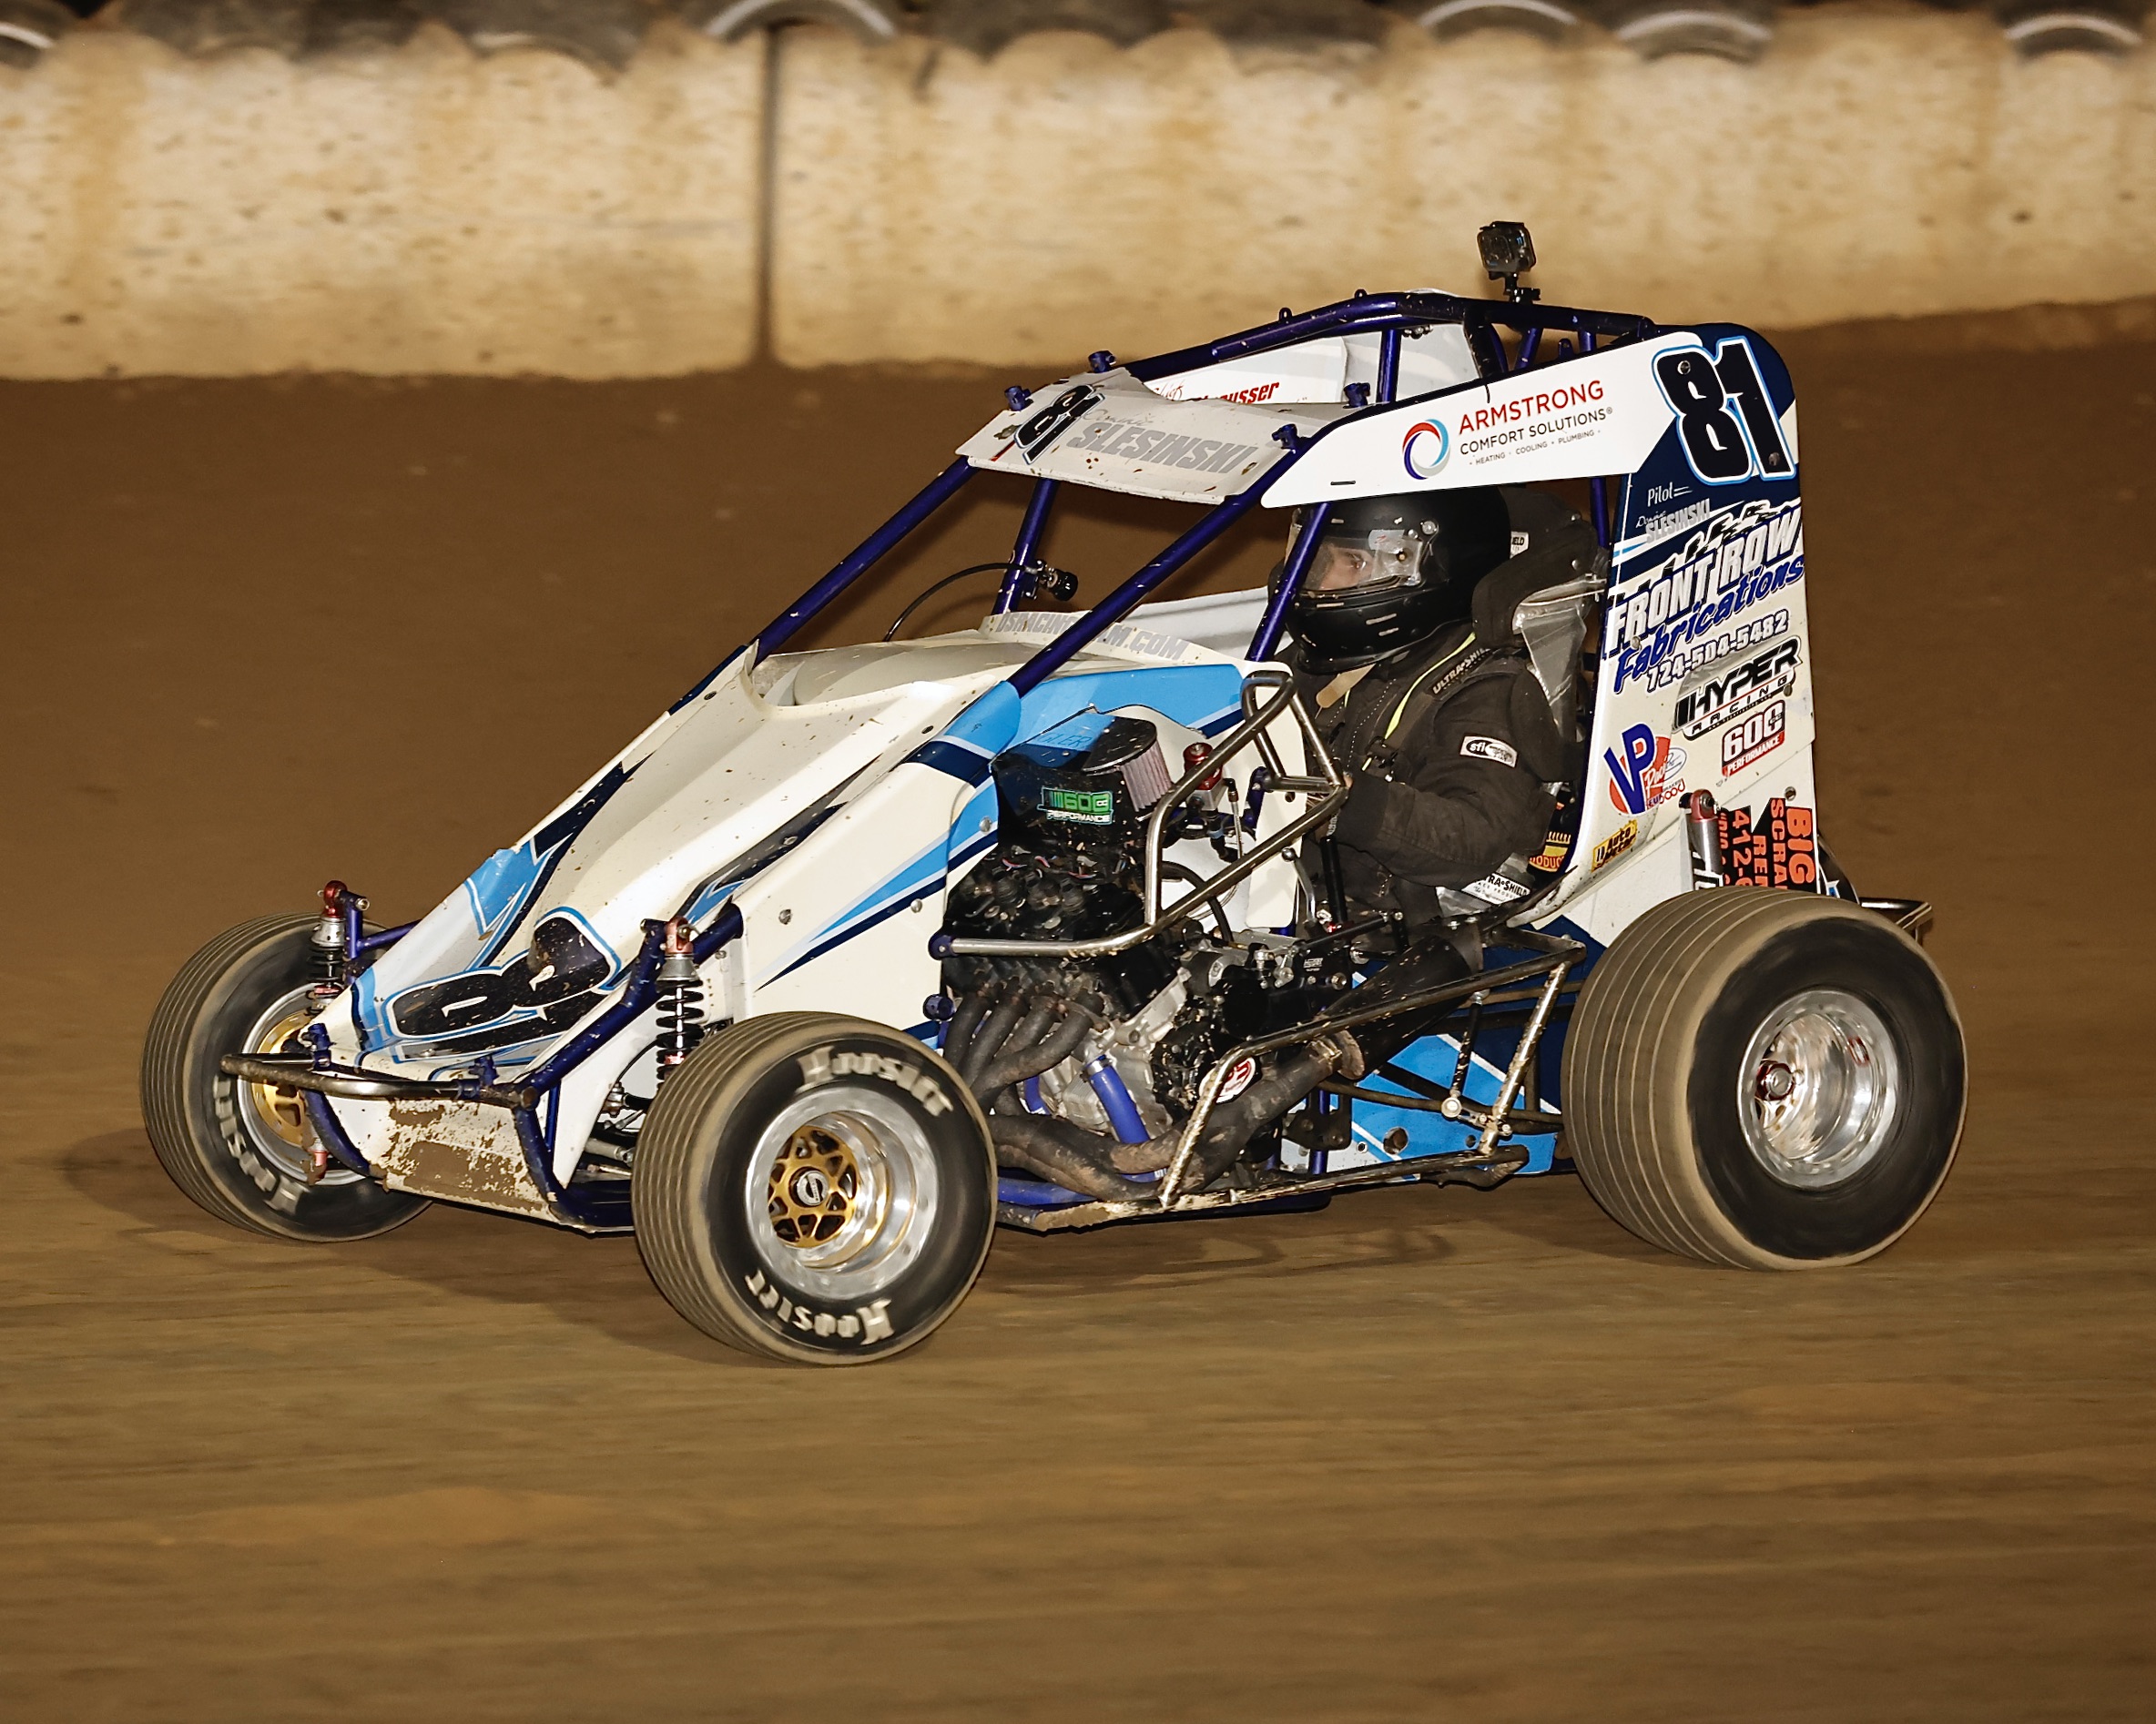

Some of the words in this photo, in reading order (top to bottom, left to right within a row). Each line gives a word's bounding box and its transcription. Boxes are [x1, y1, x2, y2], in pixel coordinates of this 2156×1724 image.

[1459, 380, 1604, 435] ARMSTRONG
[1653, 336, 1796, 485] 81
[1066, 421, 1259, 474] SLESINSKI
[1459, 429, 1525, 455] COMFORT
[1475, 452, 1506, 465] HEATING
[1516, 441, 1548, 455] COOLING
[1558, 430, 1595, 444] PLUMBING
[1645, 498, 1711, 543] SLESINSKI
[1647, 482, 1676, 507] Pilot
[1603, 550, 1714, 655] FRONT
[1717, 506, 1802, 592] ROW
[1613, 555, 1805, 695] Fabrications
[1647, 609, 1790, 692] 724-504-5482
[1678, 638, 1800, 726] HYPER
[1692, 675, 1788, 735] RACING
[1603, 723, 1655, 815] VP
[1726, 734, 1781, 774] PERFORMANCE
[1607, 827, 1632, 853] Auto
[1786, 807, 1815, 884] BIG
